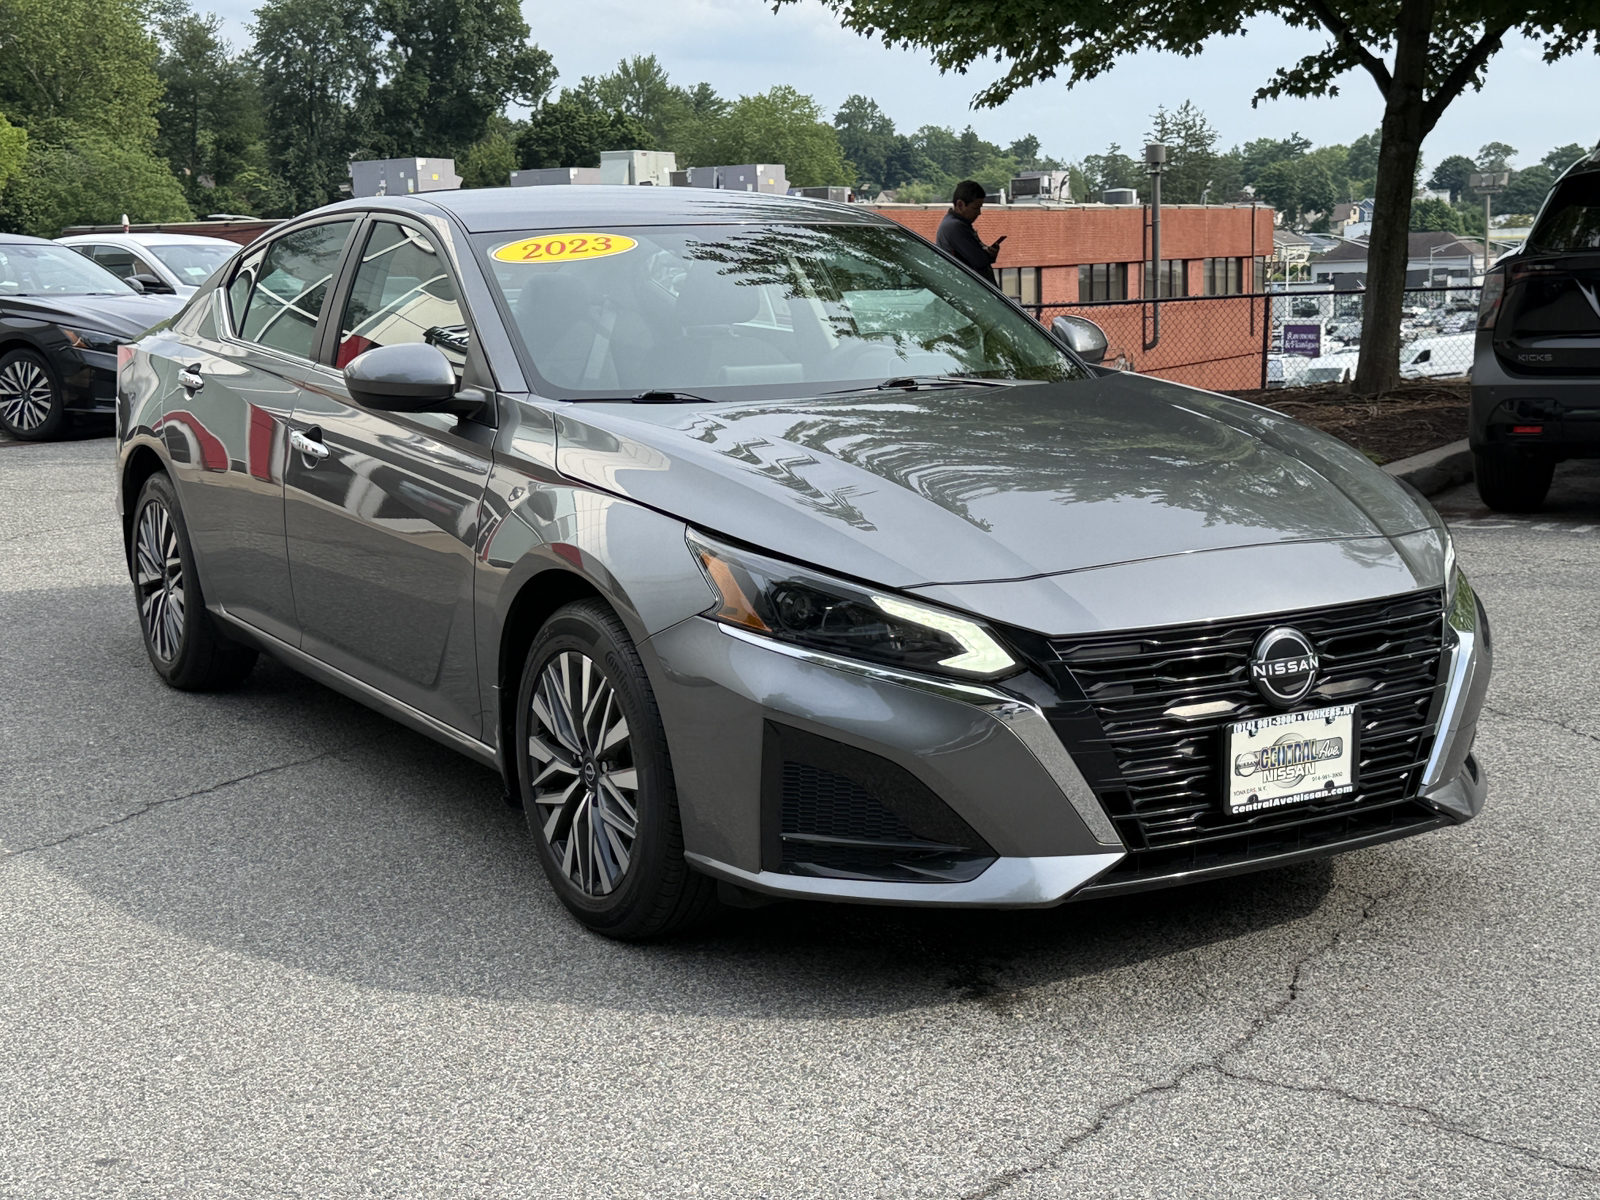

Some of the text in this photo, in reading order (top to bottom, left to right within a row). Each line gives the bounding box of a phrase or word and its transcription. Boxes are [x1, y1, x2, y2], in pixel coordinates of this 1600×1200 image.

[522, 237, 612, 260] 2023
[1253, 656, 1319, 677] NISSAN
[605, 651, 643, 731] Continental
[1260, 739, 1317, 770] CENTRAL
[1262, 762, 1316, 783] NISSAN
[1232, 786, 1353, 814] CentralAveNissan.com
